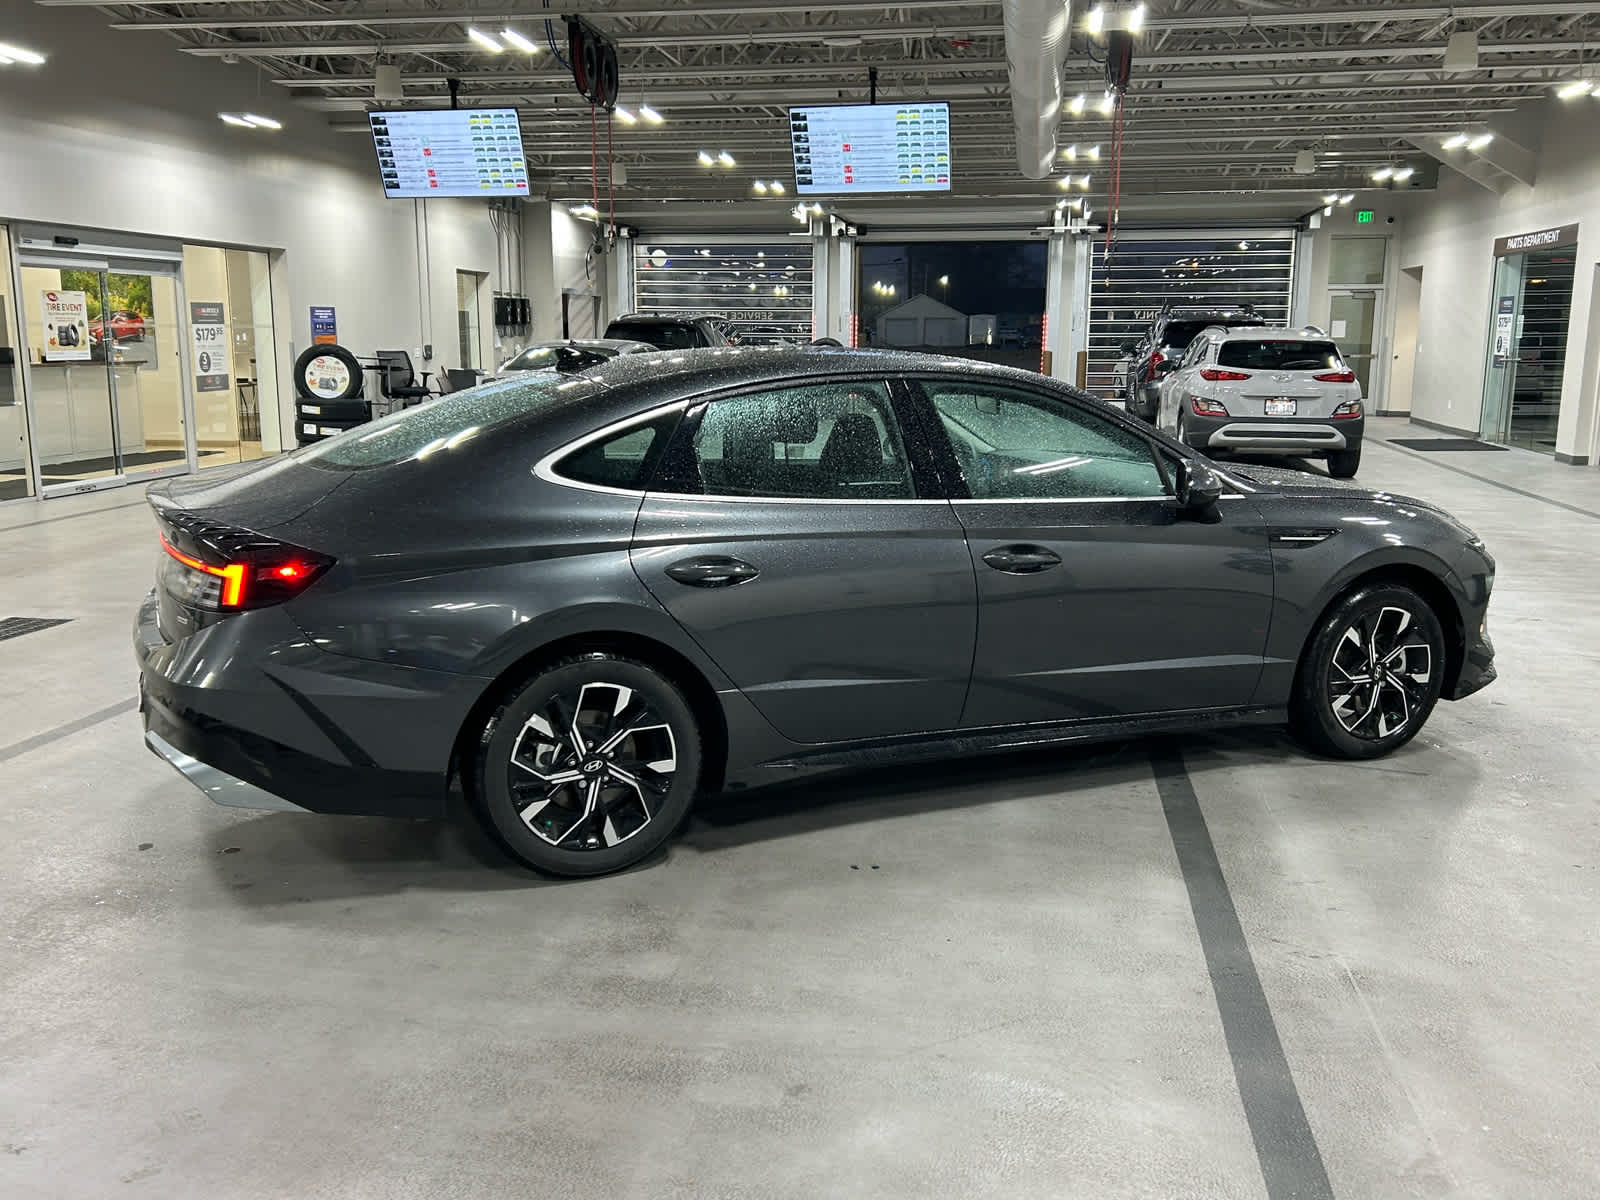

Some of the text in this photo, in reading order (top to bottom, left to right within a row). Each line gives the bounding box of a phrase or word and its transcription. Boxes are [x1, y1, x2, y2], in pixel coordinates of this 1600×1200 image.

[1359, 211, 1373, 223] EXIT
[1506, 230, 1560, 249] PARTS DEPARTMENT
[47, 303, 82, 311] TIRE EVENT
